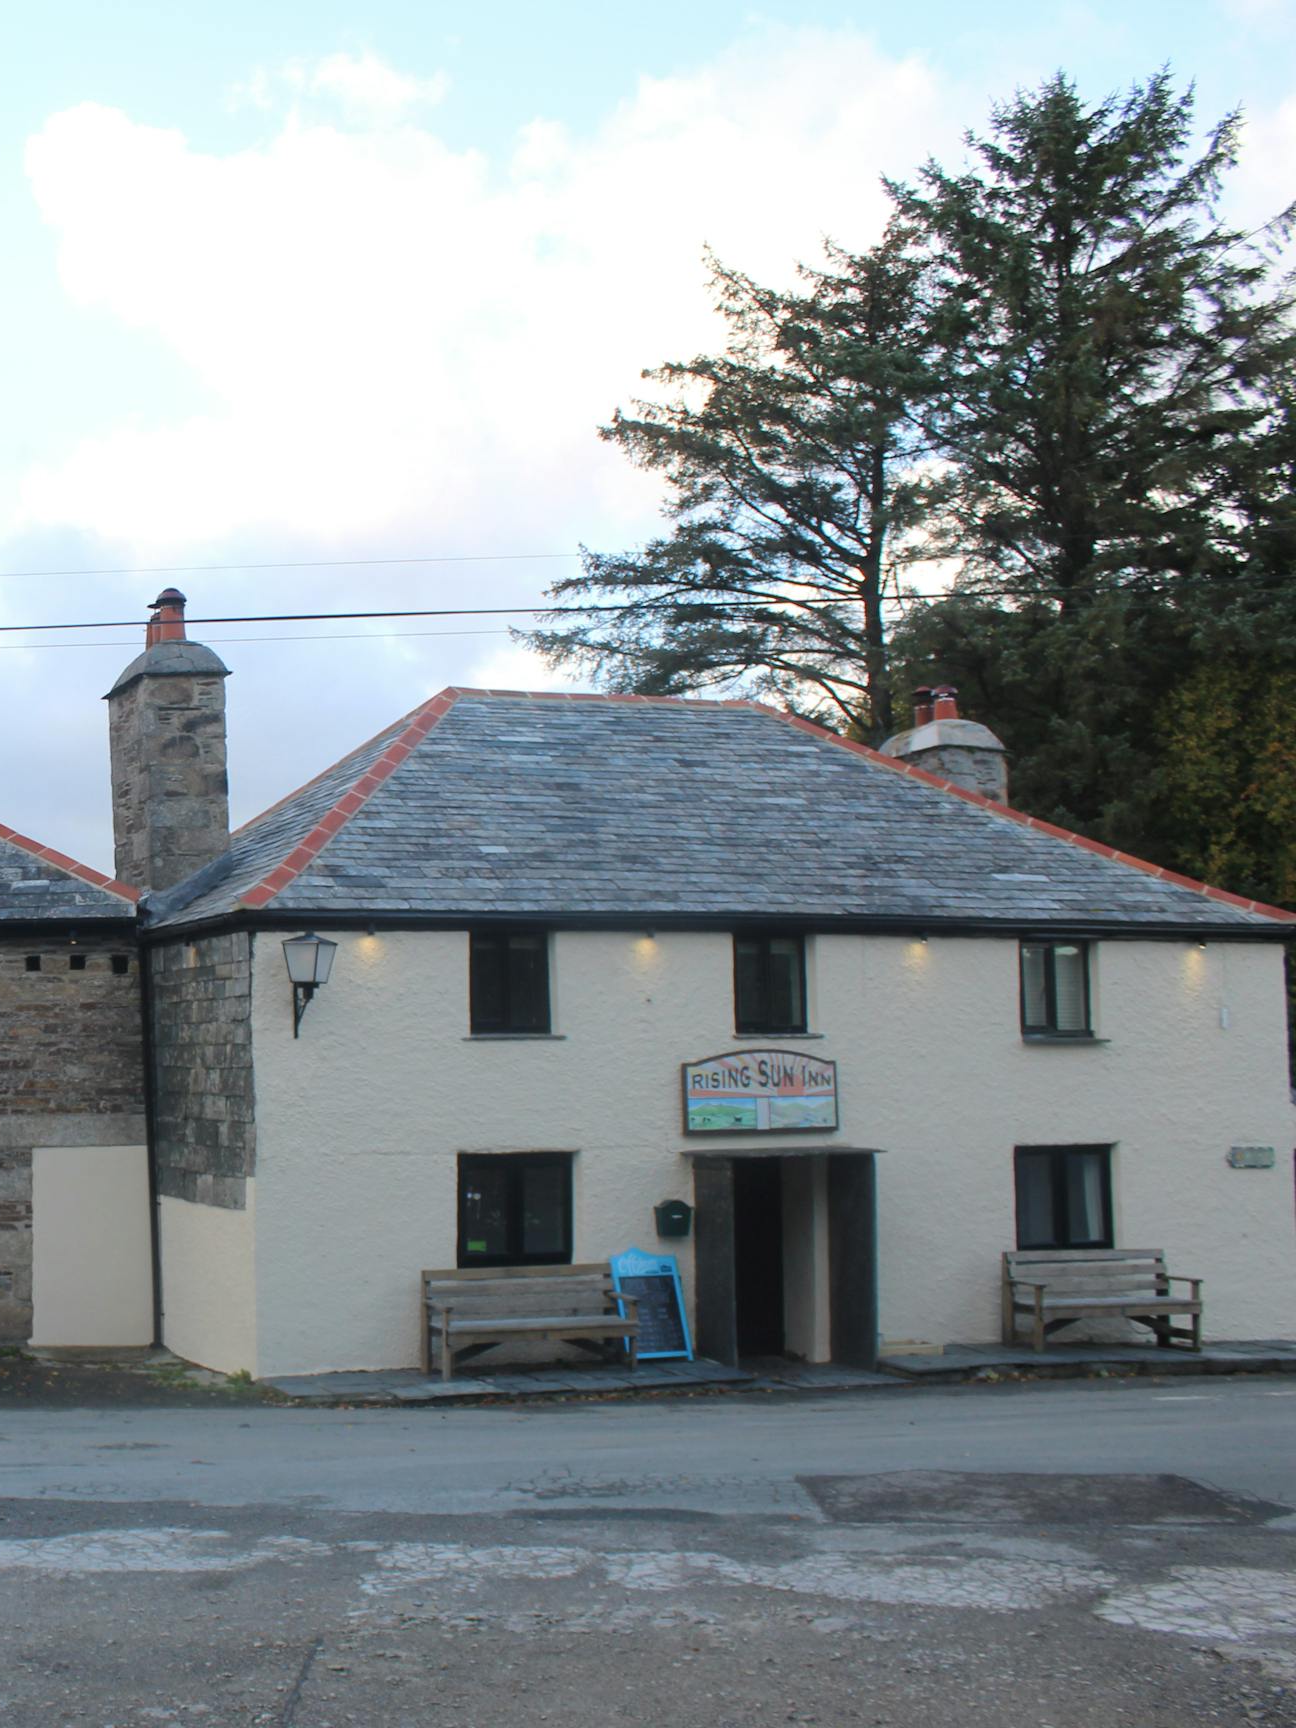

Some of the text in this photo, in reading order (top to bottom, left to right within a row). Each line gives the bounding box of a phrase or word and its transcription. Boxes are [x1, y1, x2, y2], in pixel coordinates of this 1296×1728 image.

[692, 1060, 832, 1089] RISING SUN INN
